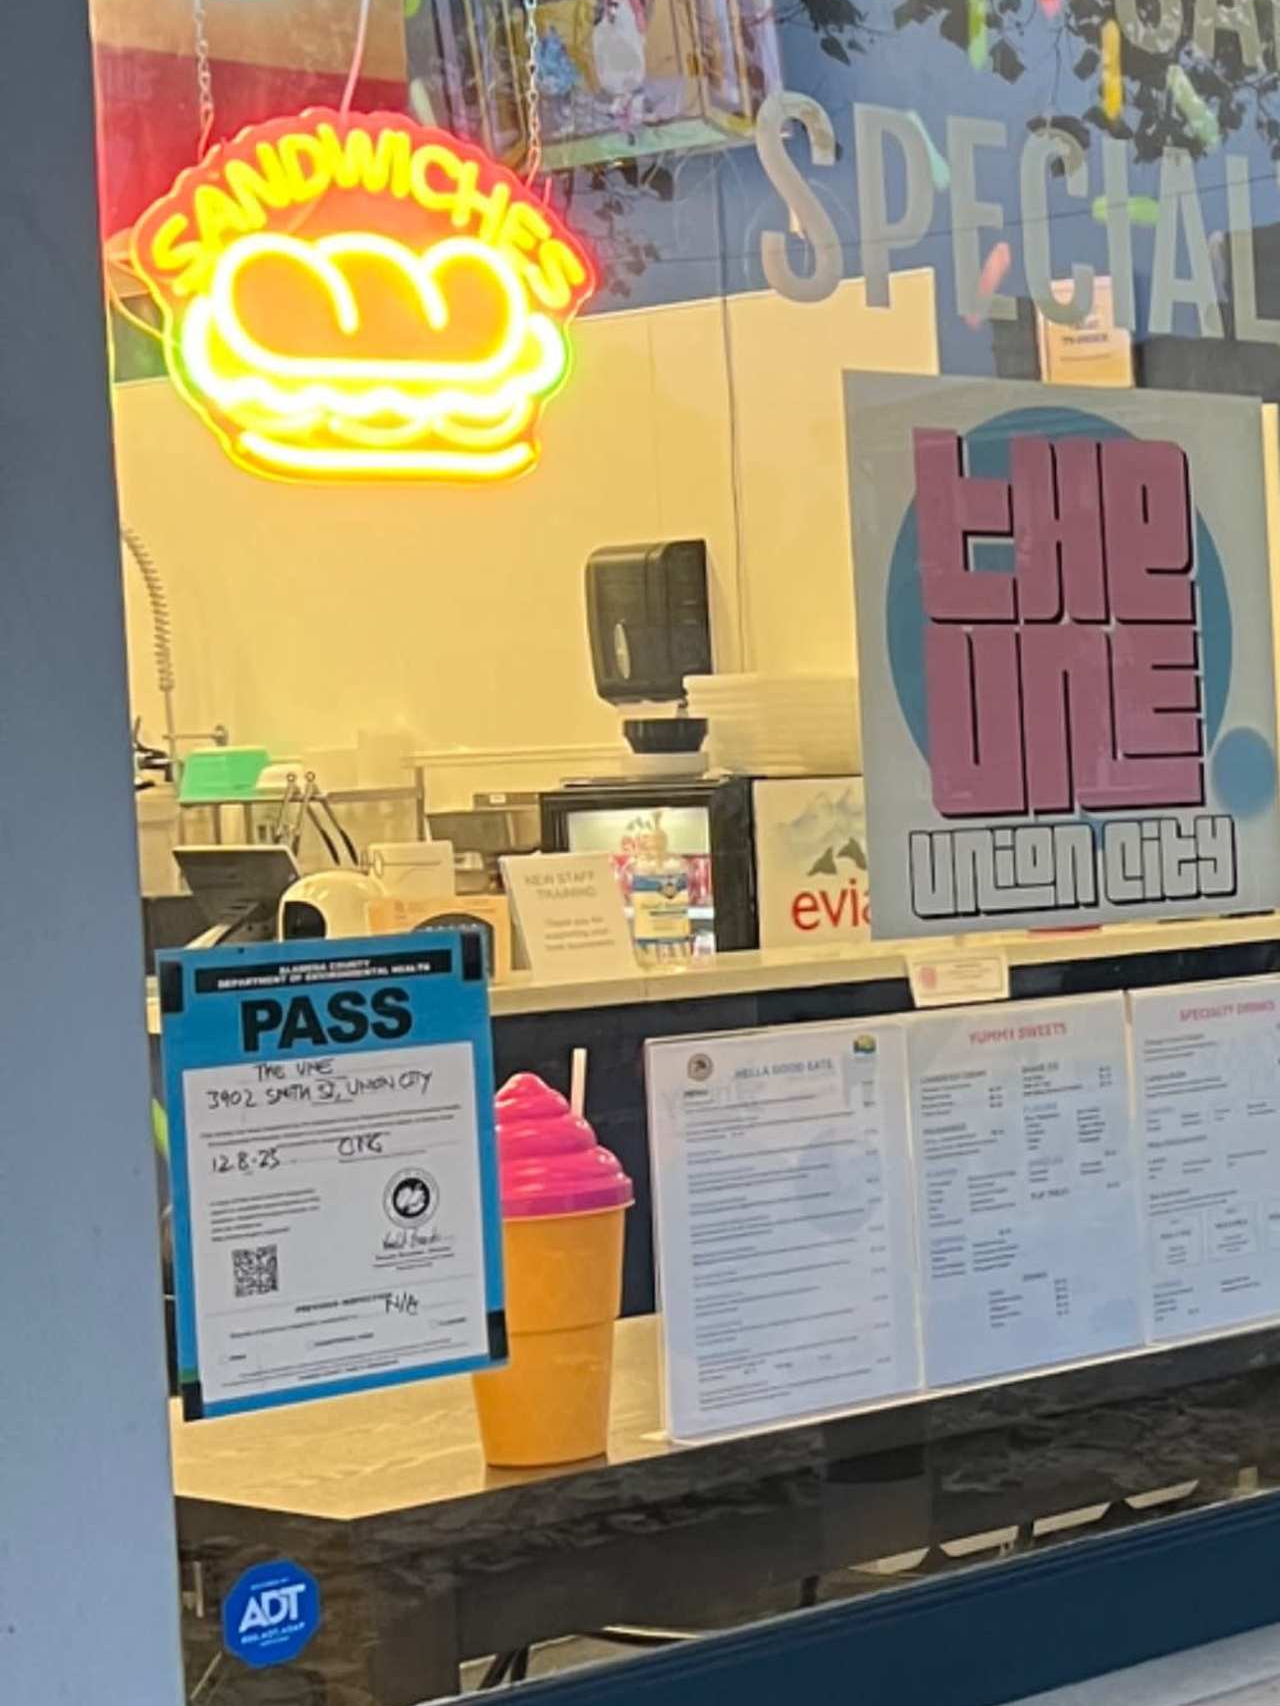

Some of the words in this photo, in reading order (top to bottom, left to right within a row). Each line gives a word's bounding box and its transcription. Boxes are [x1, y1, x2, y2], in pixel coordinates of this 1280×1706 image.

[151, 123, 586, 309] SANDWICHES
[240, 986, 413, 1053] PASS
[238, 1582, 307, 1634] ADT
